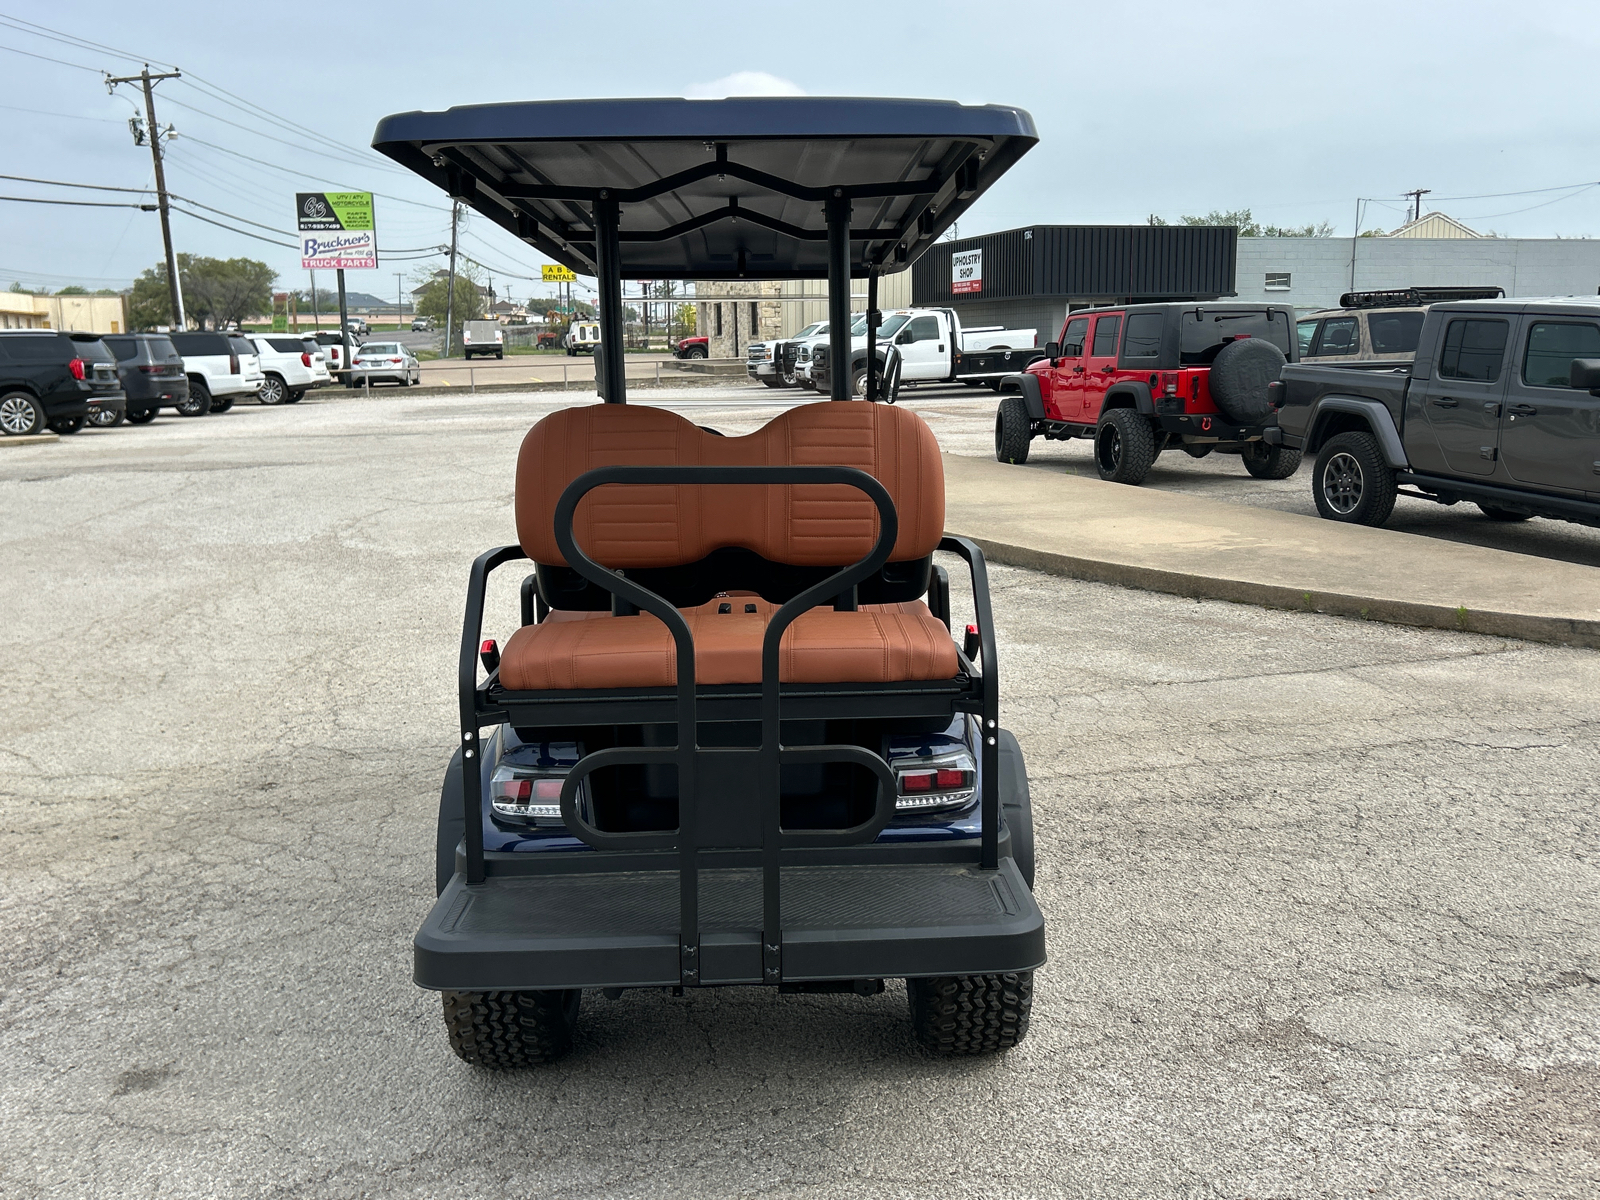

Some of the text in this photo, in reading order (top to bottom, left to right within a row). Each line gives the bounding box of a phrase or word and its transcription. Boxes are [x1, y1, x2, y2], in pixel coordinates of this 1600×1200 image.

[304, 233, 370, 258] Bruckner's
[340, 259, 373, 267] PARTS
[953, 253, 981, 267] UPHOLSTRY
[960, 267, 974, 278] SHOP
